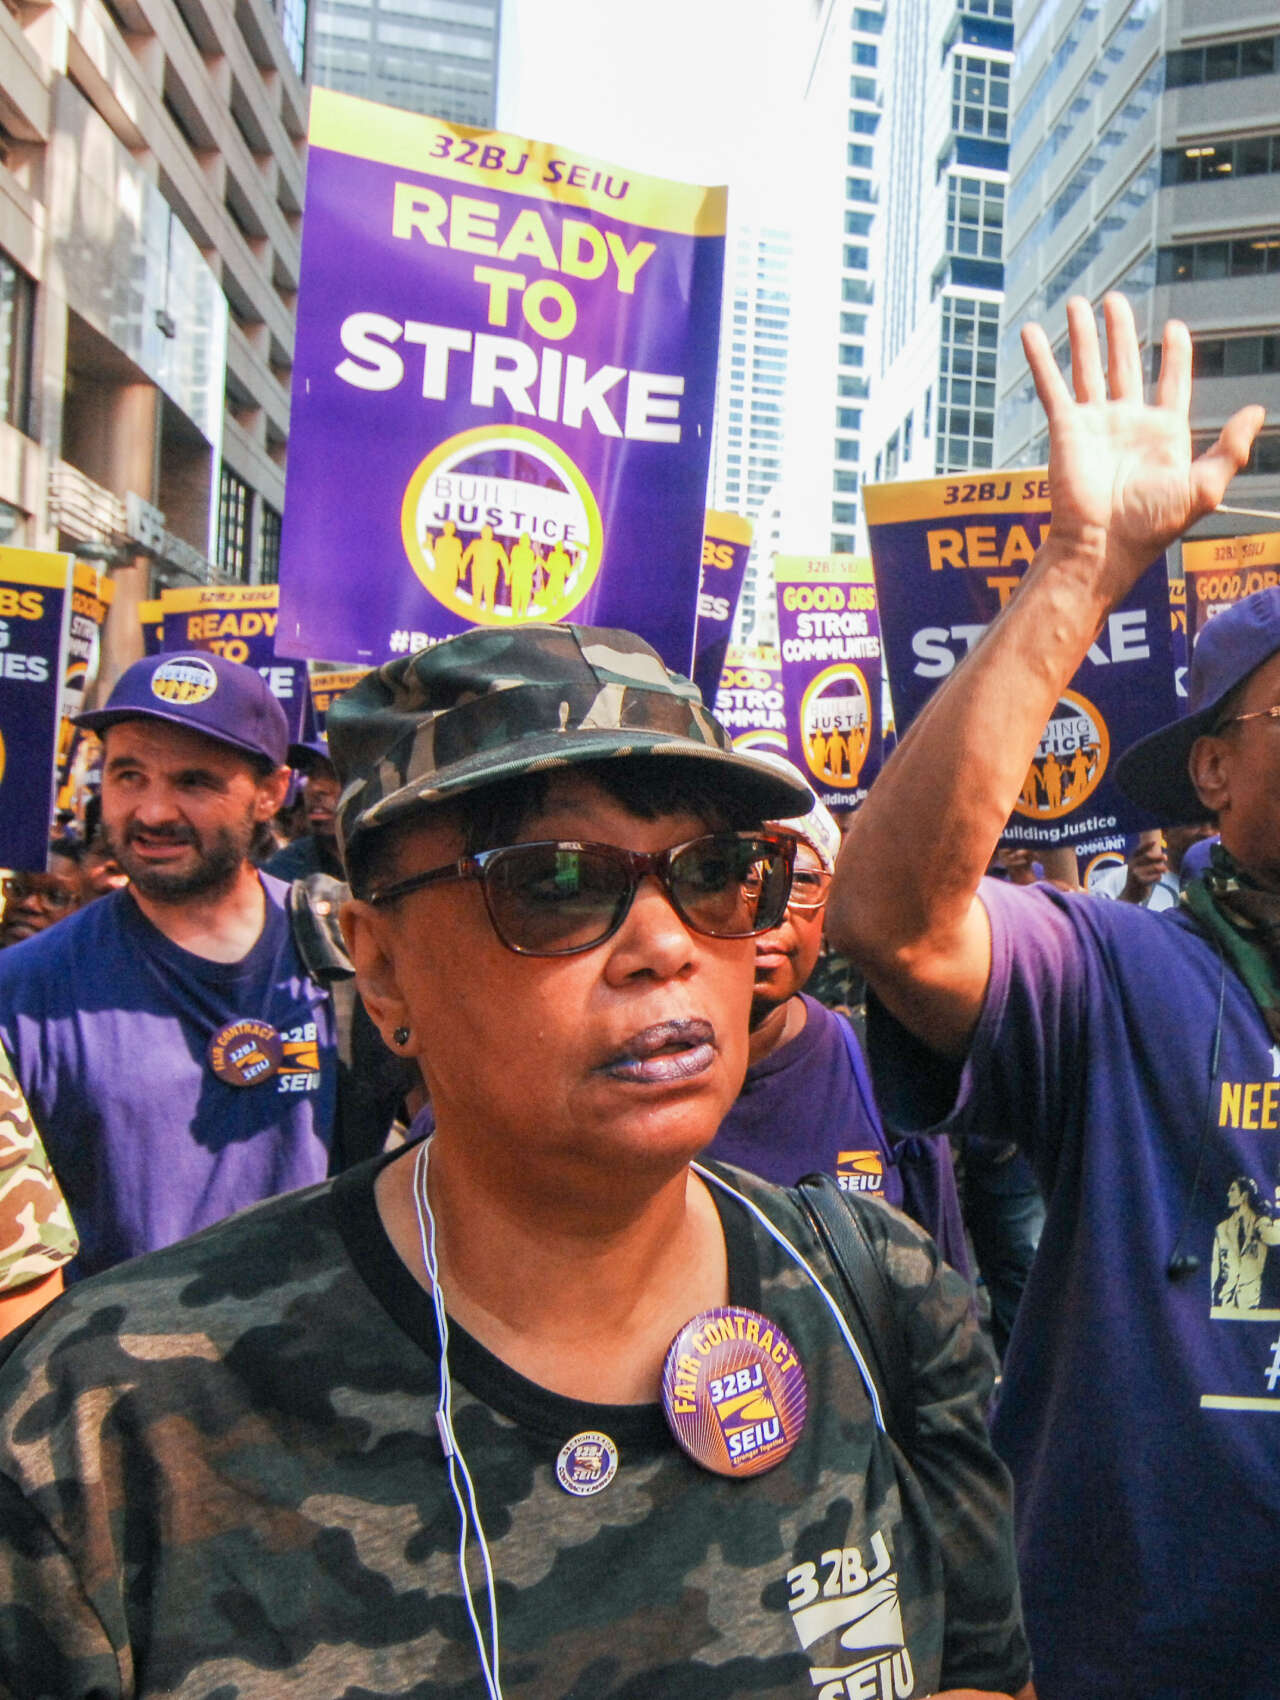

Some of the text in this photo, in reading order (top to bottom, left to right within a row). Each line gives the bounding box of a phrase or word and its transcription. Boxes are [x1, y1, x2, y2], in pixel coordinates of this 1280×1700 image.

[429, 134, 630, 199] 32BJ SEIU
[391, 181, 657, 294] READY
[473, 265, 577, 340] TO
[334, 311, 685, 443] STRIKE
[943, 480, 1050, 505] 32BJ SE
[433, 501, 577, 542] JUSTICE
[702, 540, 735, 570] BS
[926, 524, 1051, 571] REA
[783, 586, 846, 612] GOOD
[986, 576, 1020, 611] T
[1195, 575, 1241, 600] GOOD
[0, 587, 44, 621] BS
[187, 612, 278, 641] READY
[208, 639, 249, 664] TO
[719, 668, 773, 690] OOD
[716, 689, 785, 709] STRO
[1039, 734, 1091, 754] TICE
[1000, 816, 1117, 842] uildingJustice
[279, 1022, 317, 1042] 2B
[242, 1058, 271, 1081] SEIU
[837, 1175, 883, 1191] SEIU
[673, 1316, 798, 1414] FAIR CONTRACT
[709, 1363, 764, 1404] 32BJ
[727, 1416, 781, 1458] SEIU
[787, 1530, 891, 1612] 32BJ
